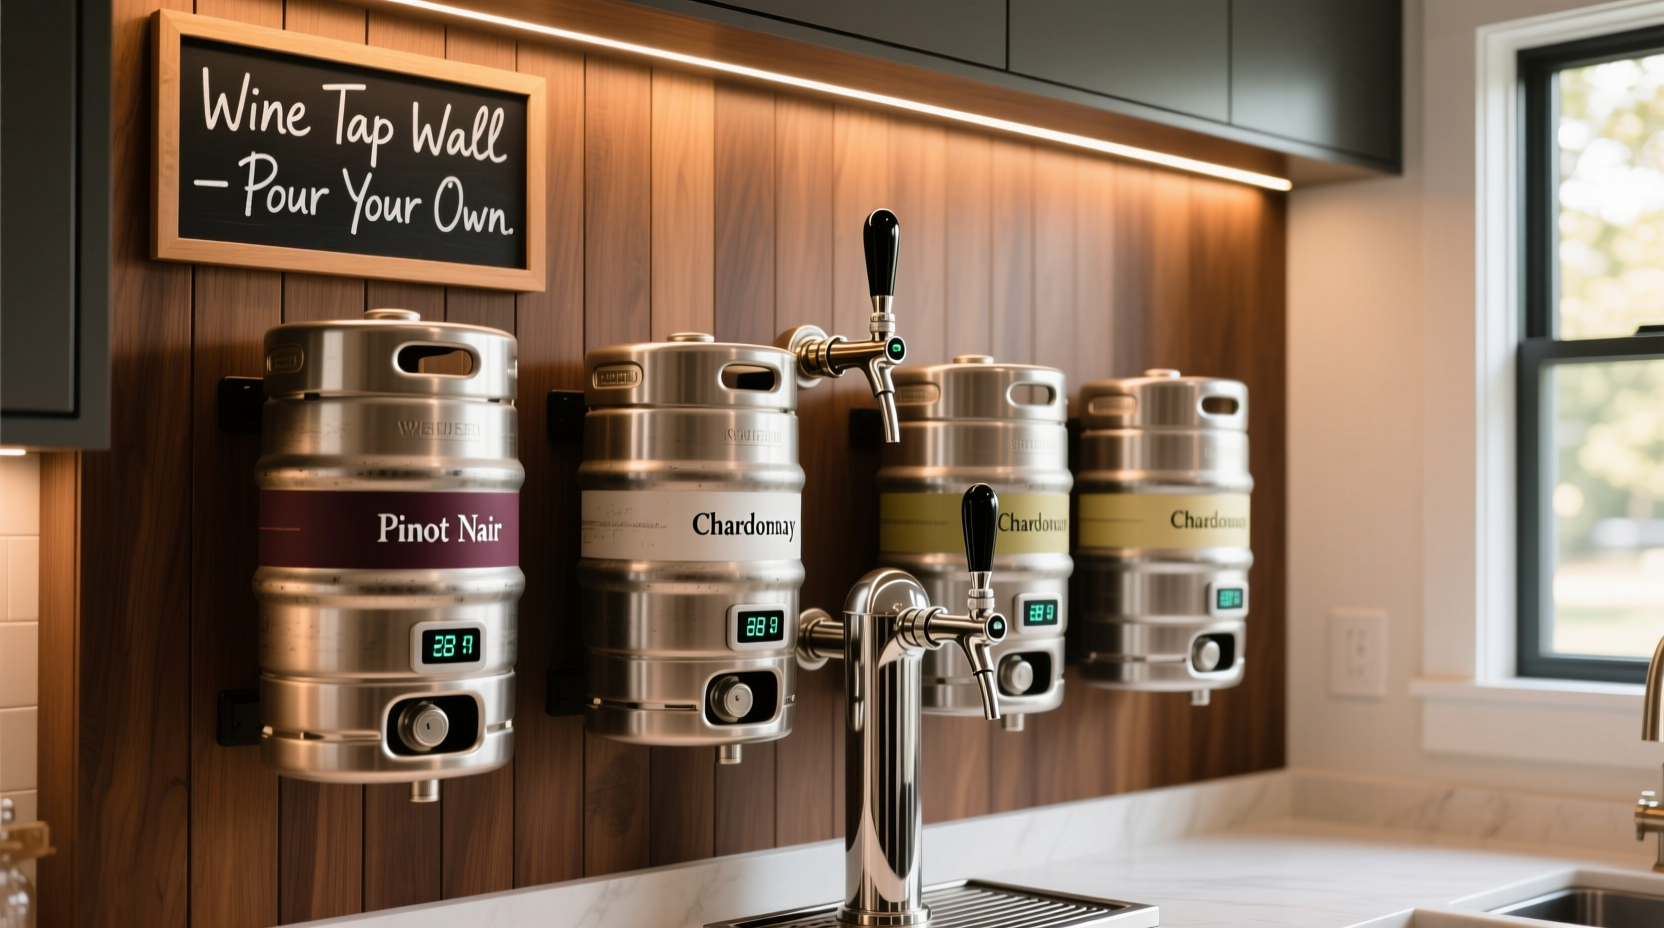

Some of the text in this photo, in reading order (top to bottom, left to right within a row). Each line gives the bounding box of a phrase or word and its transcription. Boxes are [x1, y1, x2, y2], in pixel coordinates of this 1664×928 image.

[202, 66, 507, 168] Wine Tap Wall
[342, 168, 422, 235] Your
[434, 176, 514, 236] Own.
[377, 513, 502, 543] Pinot Nair
[692, 512, 796, 543] Chardonnay
